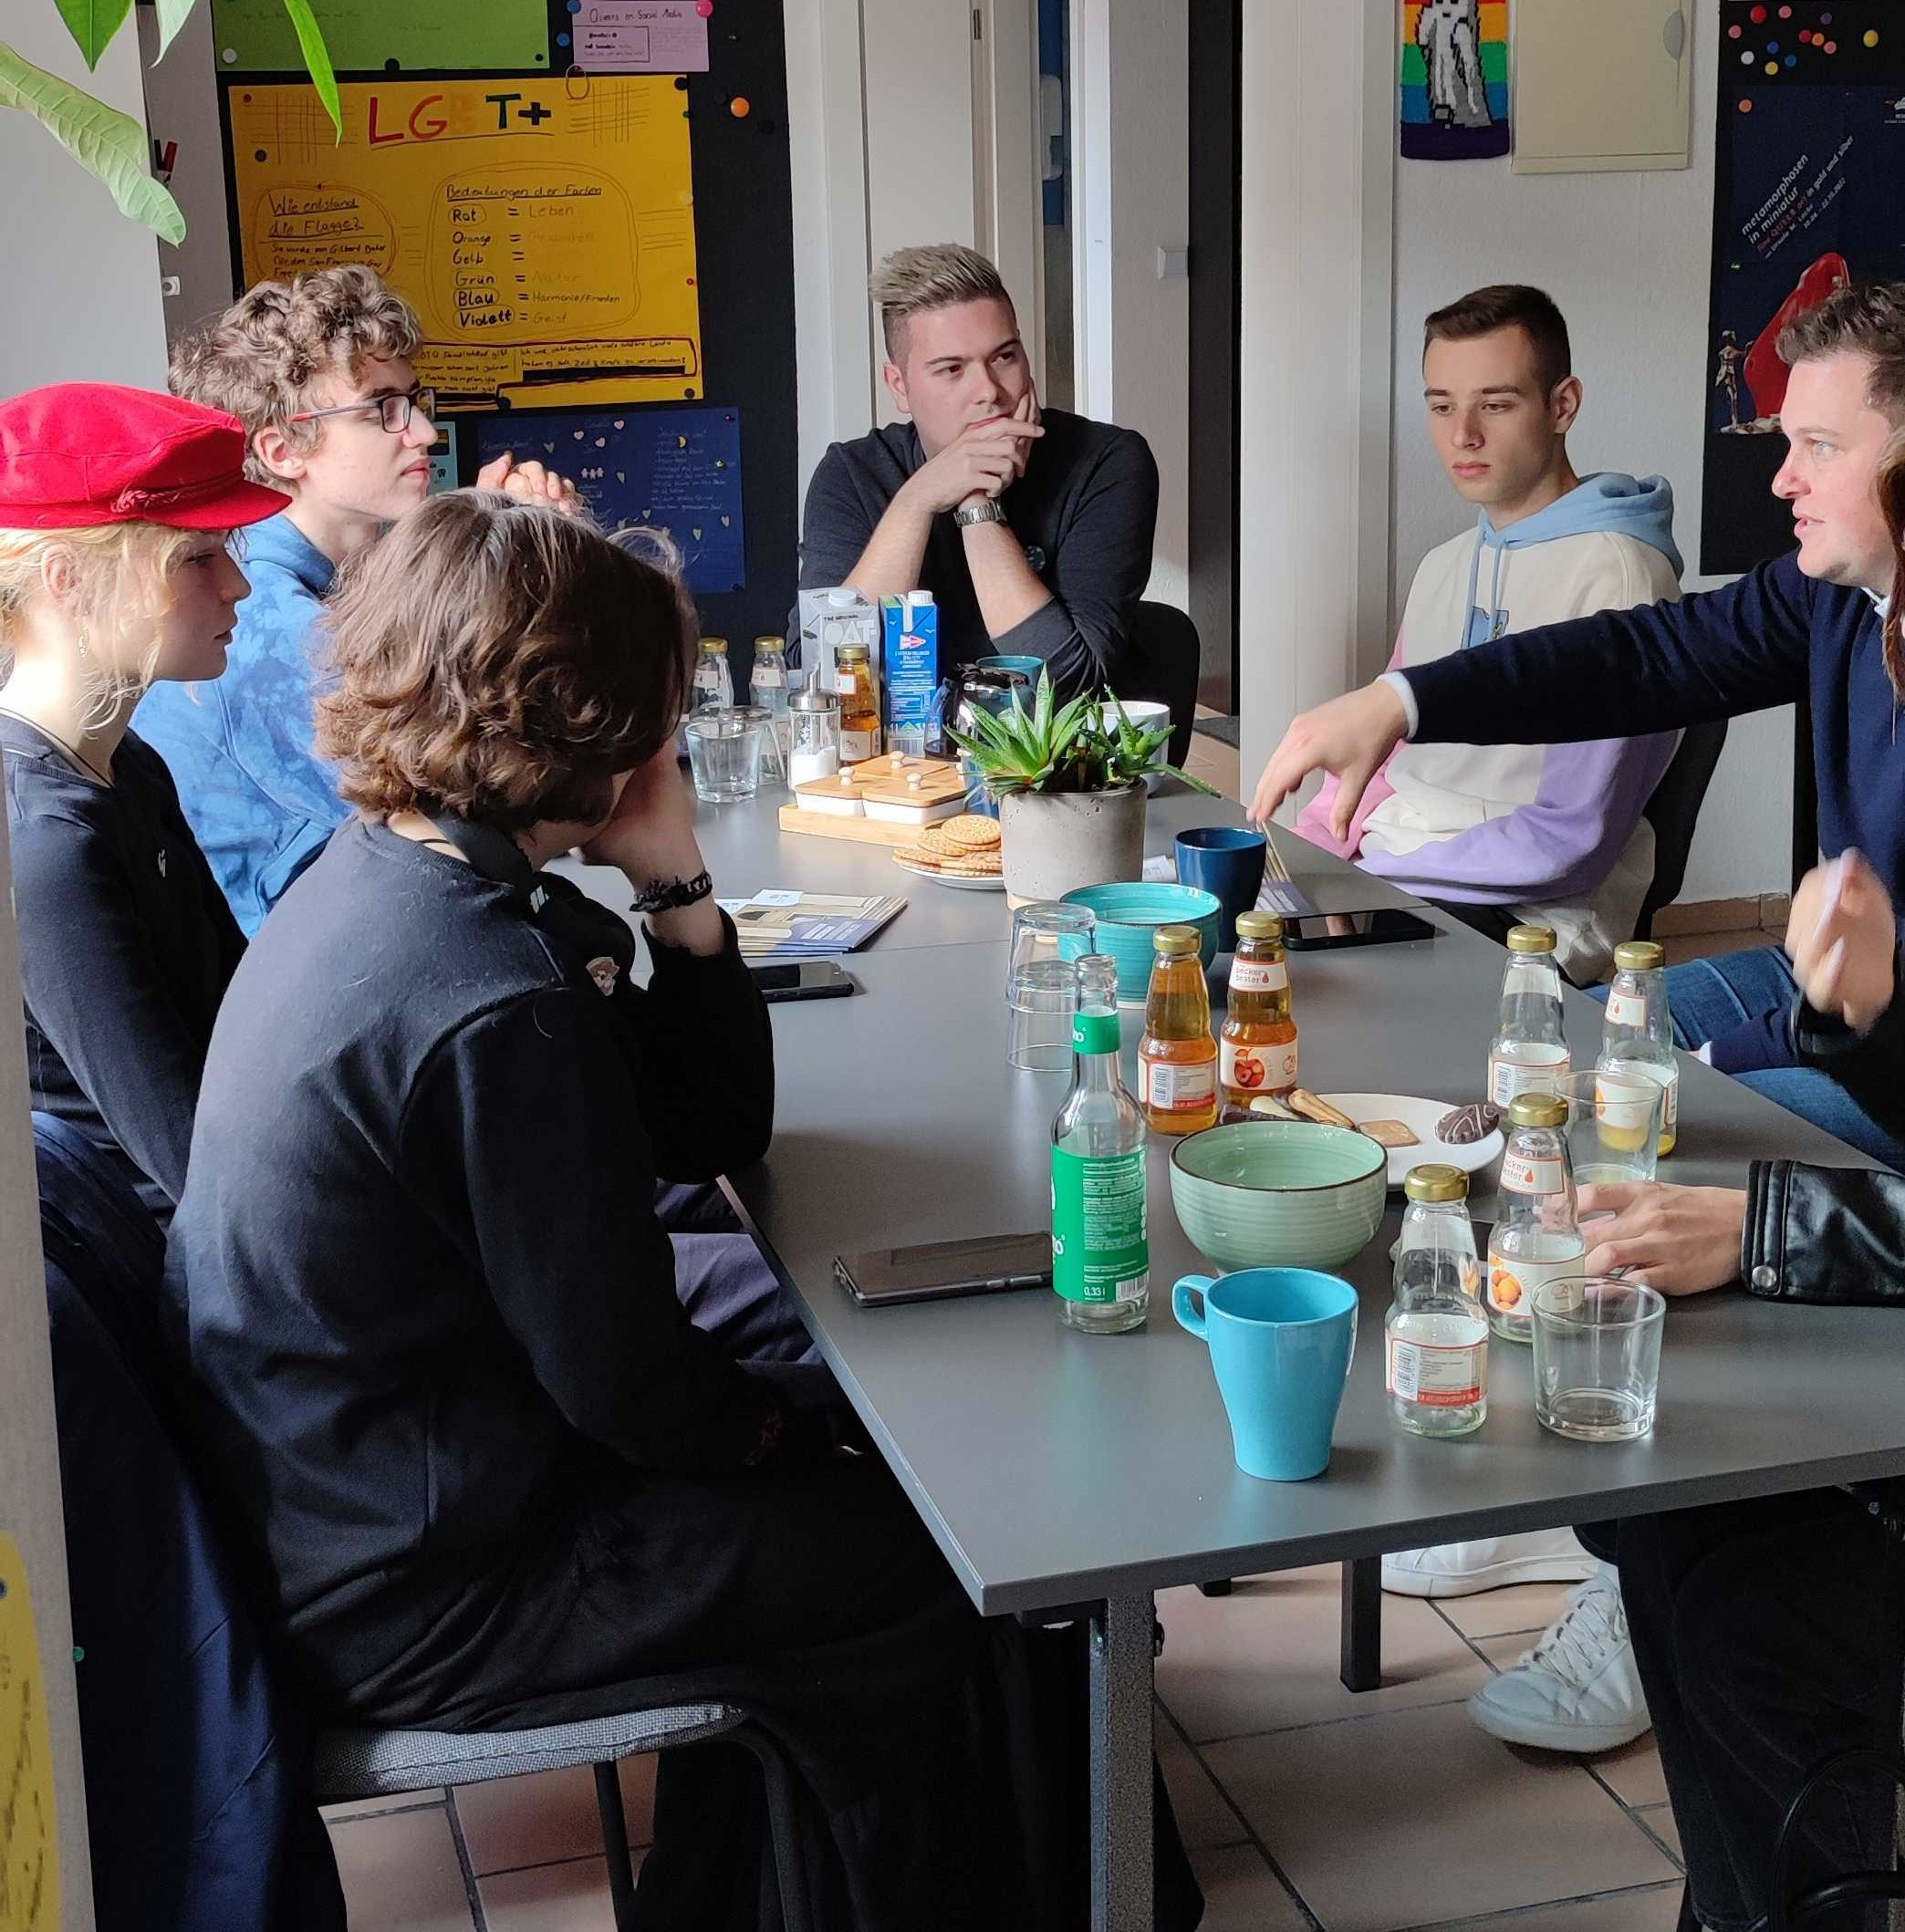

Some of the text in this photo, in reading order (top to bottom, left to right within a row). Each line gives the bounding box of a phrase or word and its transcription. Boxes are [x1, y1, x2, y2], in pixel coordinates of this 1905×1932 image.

[447, 184, 602, 201] Bedeutungen der Farben
[1742, 154, 1808, 235] metamorphosen
[268, 192, 359, 213] Wie entstand
[453, 208, 476, 223] Rot
[529, 204, 575, 219] Leben
[1749, 186, 1798, 244] in miniatur
[269, 217, 360, 235] die Flagge?
[453, 231, 491, 246] Orange
[453, 248, 484, 265] Gelb
[455, 271, 494, 286] Grün
[458, 290, 494, 307] Blau
[459, 309, 512, 327] Violett
